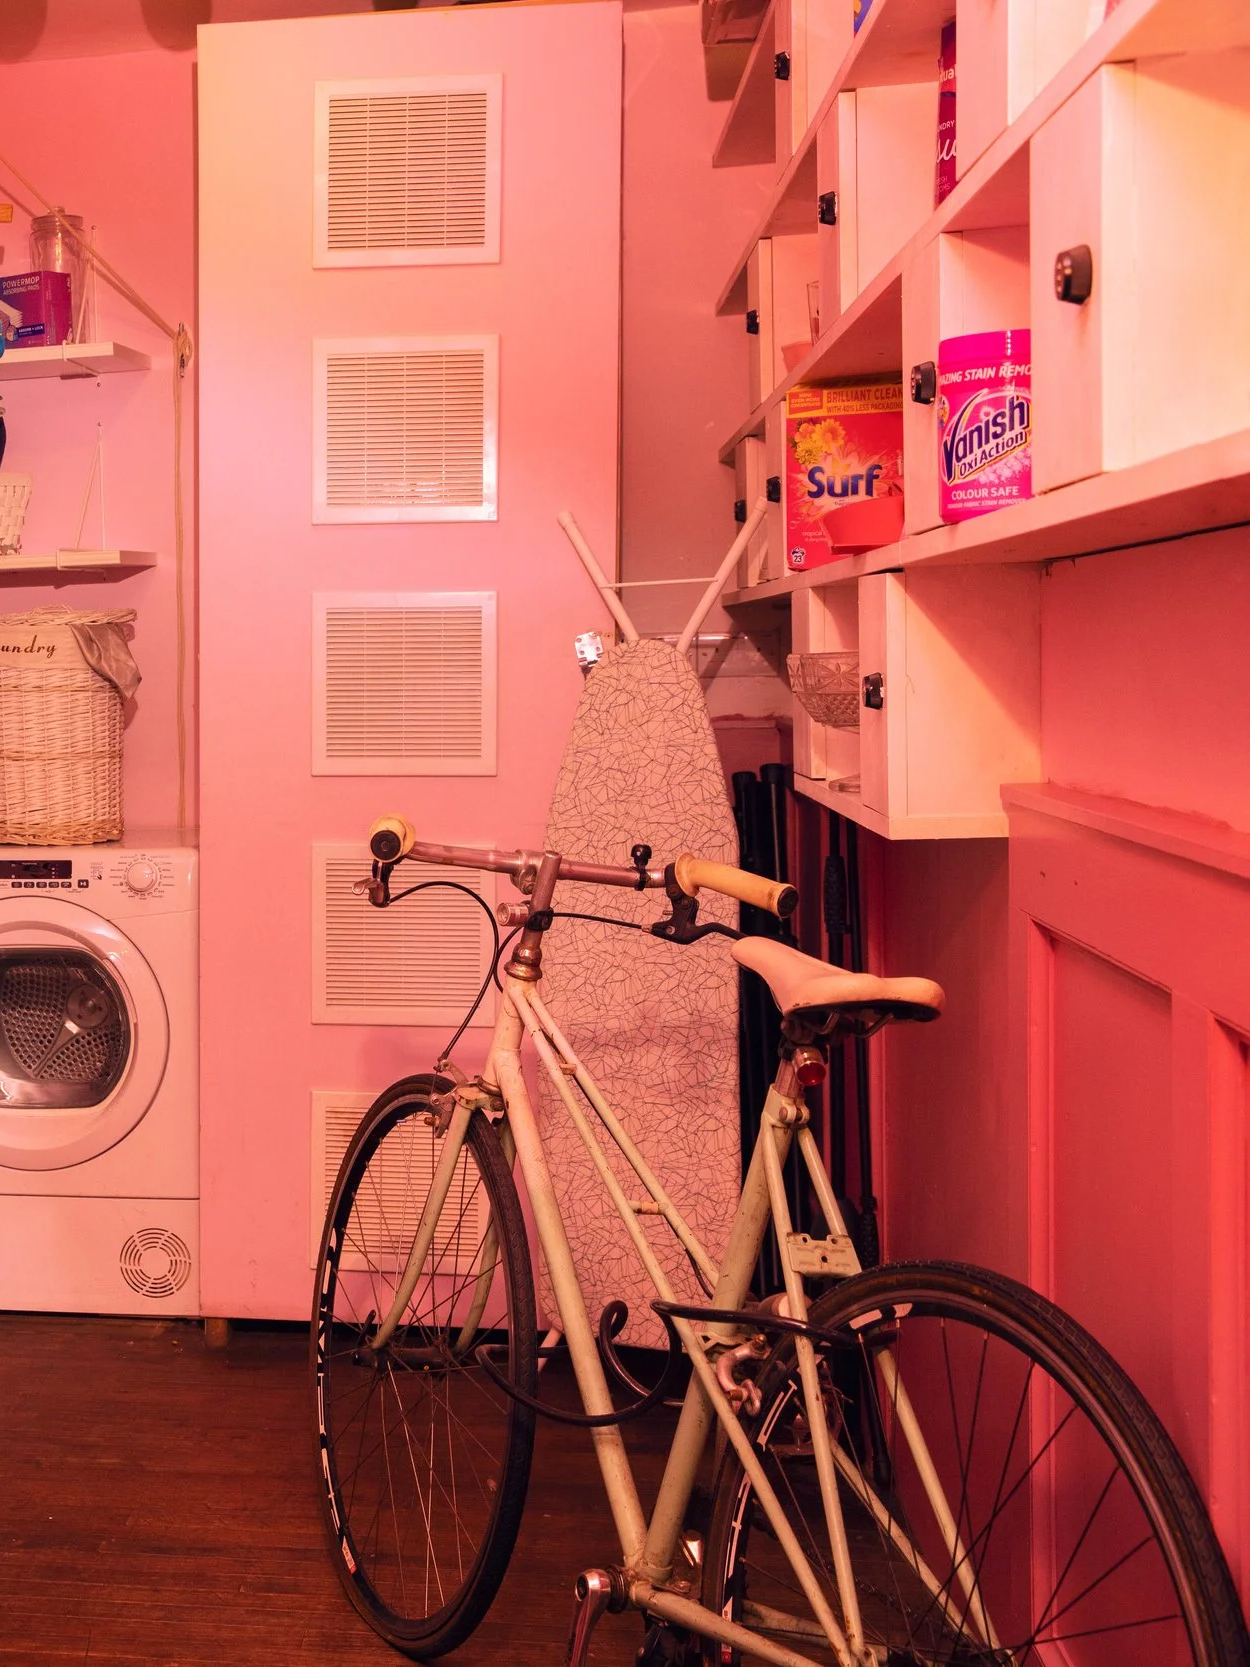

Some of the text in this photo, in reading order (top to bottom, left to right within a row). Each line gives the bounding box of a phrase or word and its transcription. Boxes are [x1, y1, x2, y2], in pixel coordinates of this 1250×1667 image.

[2, 276, 40, 289] POWERMOP
[963, 366, 996, 382] STAIN
[827, 387, 903, 403] BRILLIANT CLEAN
[943, 392, 1026, 481] Vanish
[979, 431, 1023, 465] Action
[807, 464, 883, 499] Surf
[951, 486, 1019, 501] COLOUR SAFE
[793, 555, 802, 563] 23
